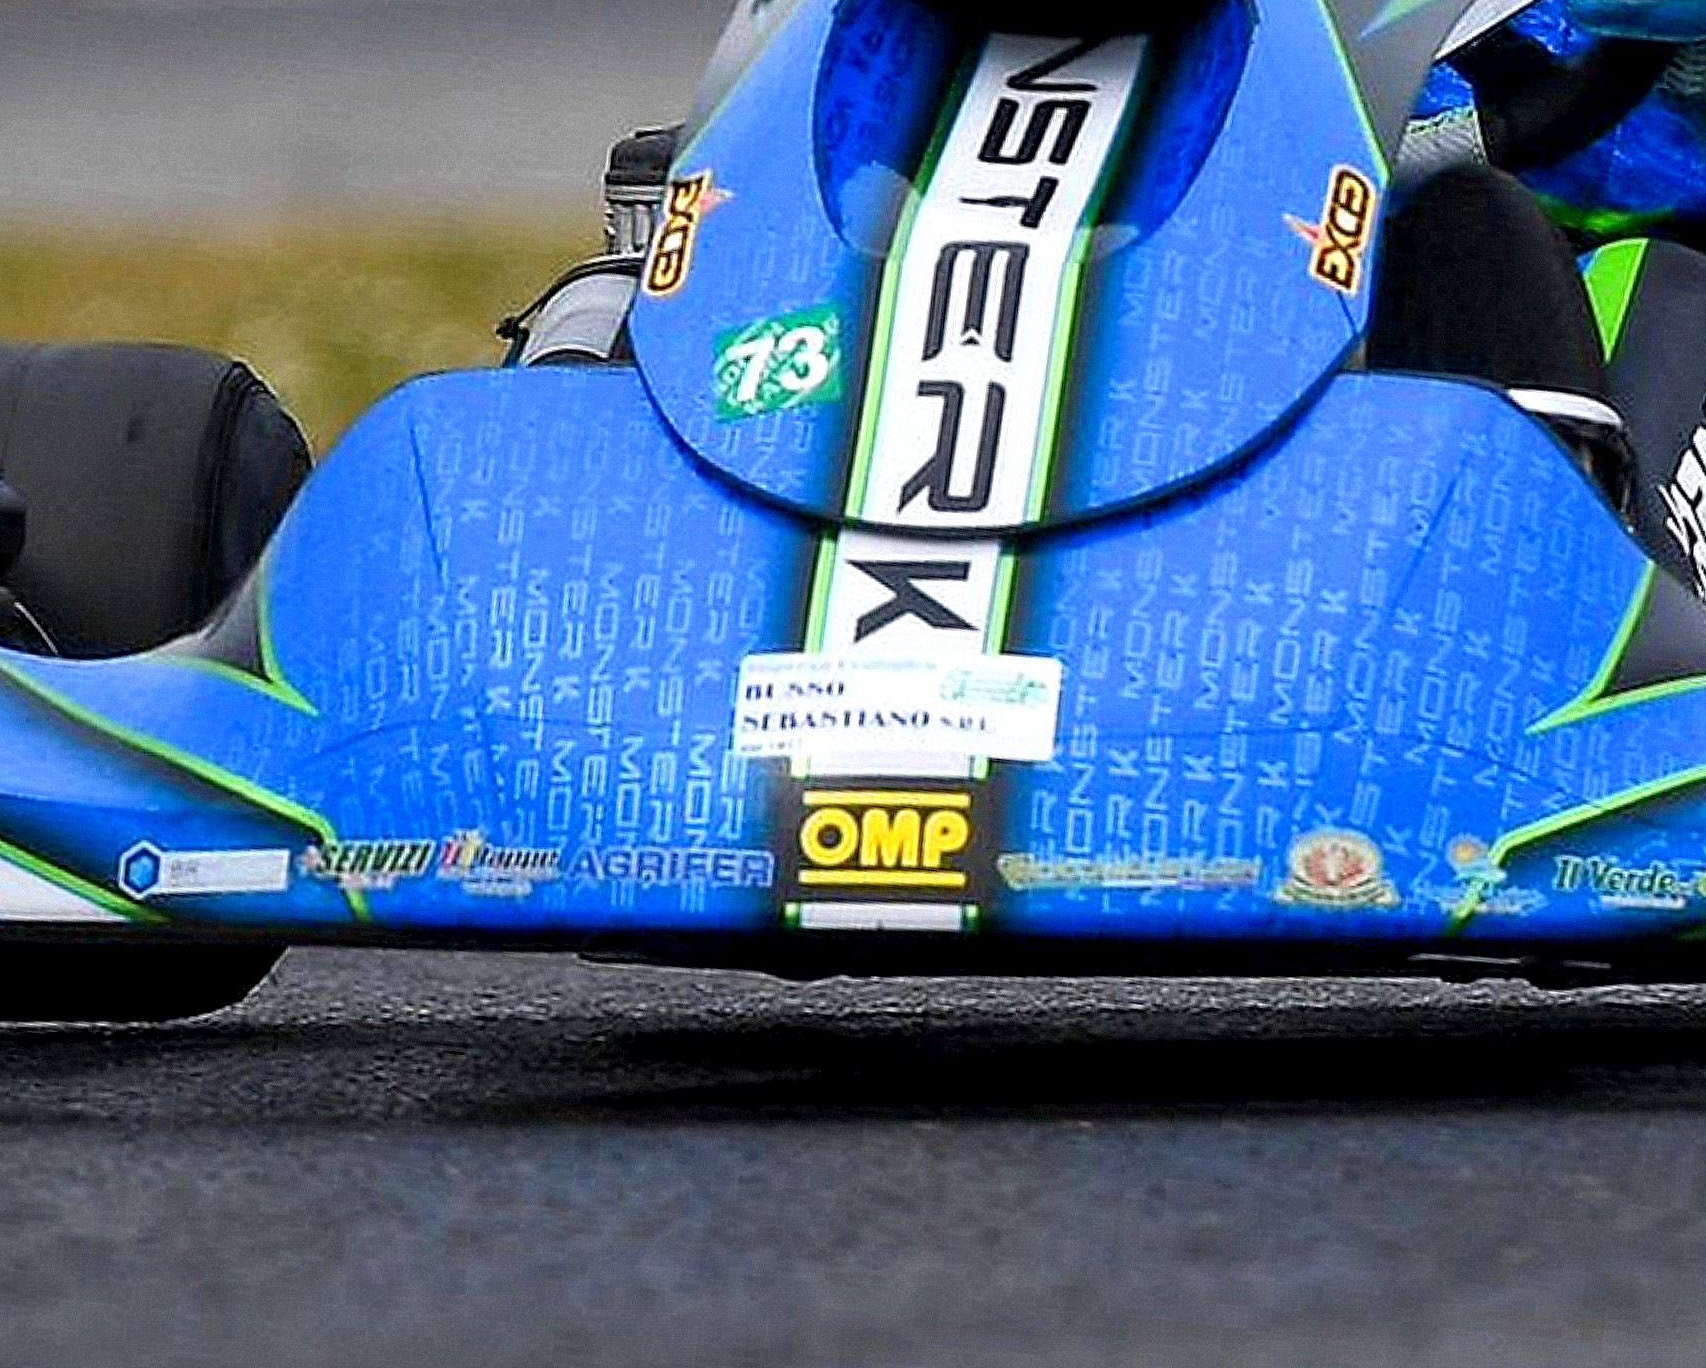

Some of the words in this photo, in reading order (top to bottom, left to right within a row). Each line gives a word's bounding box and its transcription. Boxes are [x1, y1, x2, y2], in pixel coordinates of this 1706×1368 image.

[725, 324, 829, 402] 73
[843, 559, 981, 645] K
[742, 710, 931, 732] SEBASTIANO
[574, 847, 776, 889] AGRIFER
[799, 808, 971, 870] OMP
